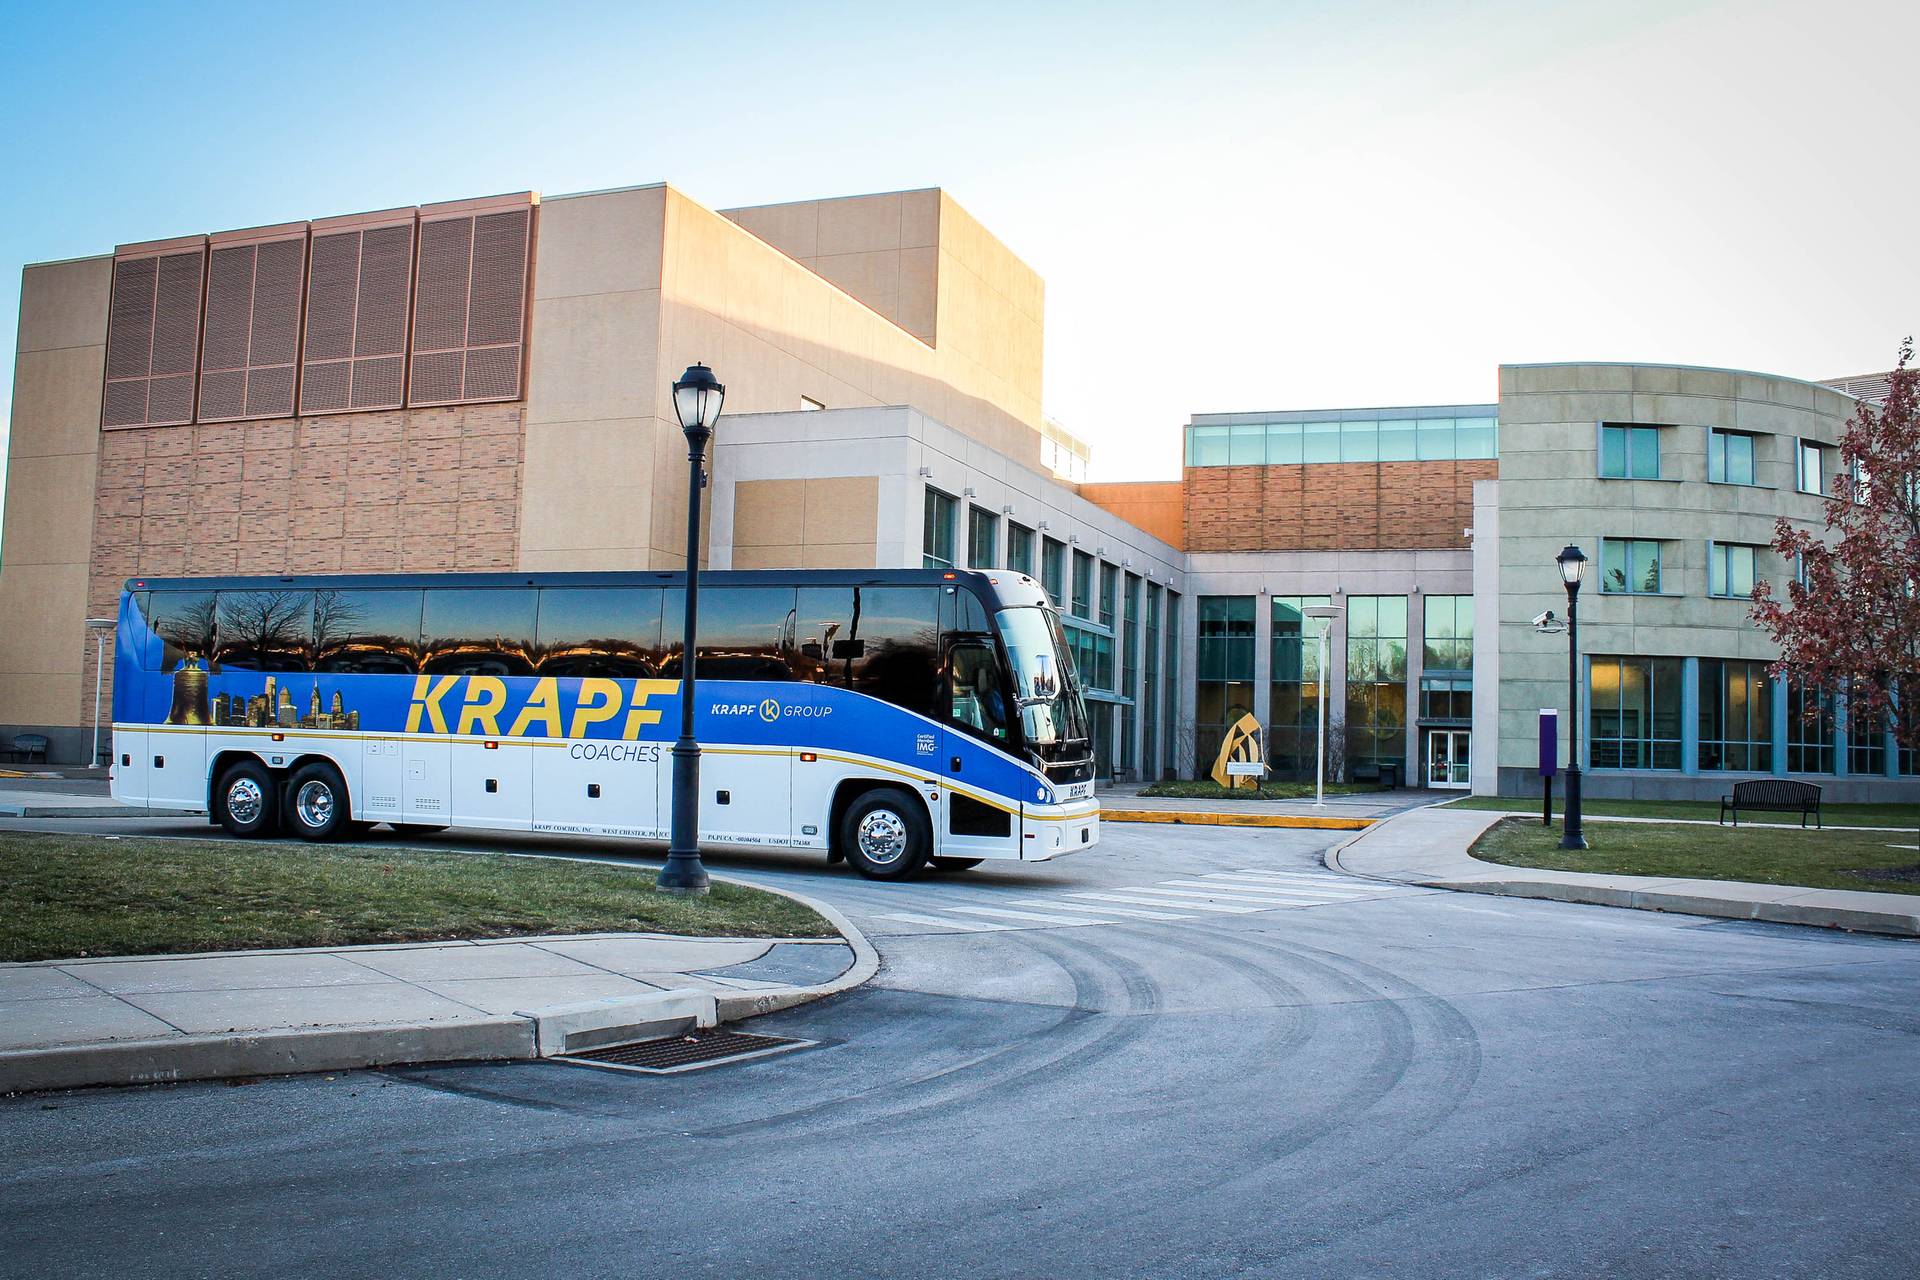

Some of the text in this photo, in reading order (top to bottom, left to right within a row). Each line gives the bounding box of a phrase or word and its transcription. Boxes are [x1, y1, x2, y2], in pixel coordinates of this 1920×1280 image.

[404, 675, 681, 740] KRAPF
[710, 703, 756, 717] KRAPF
[783, 704, 833, 719] GROUP
[570, 743, 661, 763] COACHES
[916, 743, 935, 751] IMG
[1069, 784, 1087, 797] KRAPF
[601, 827, 618, 835] WEST
